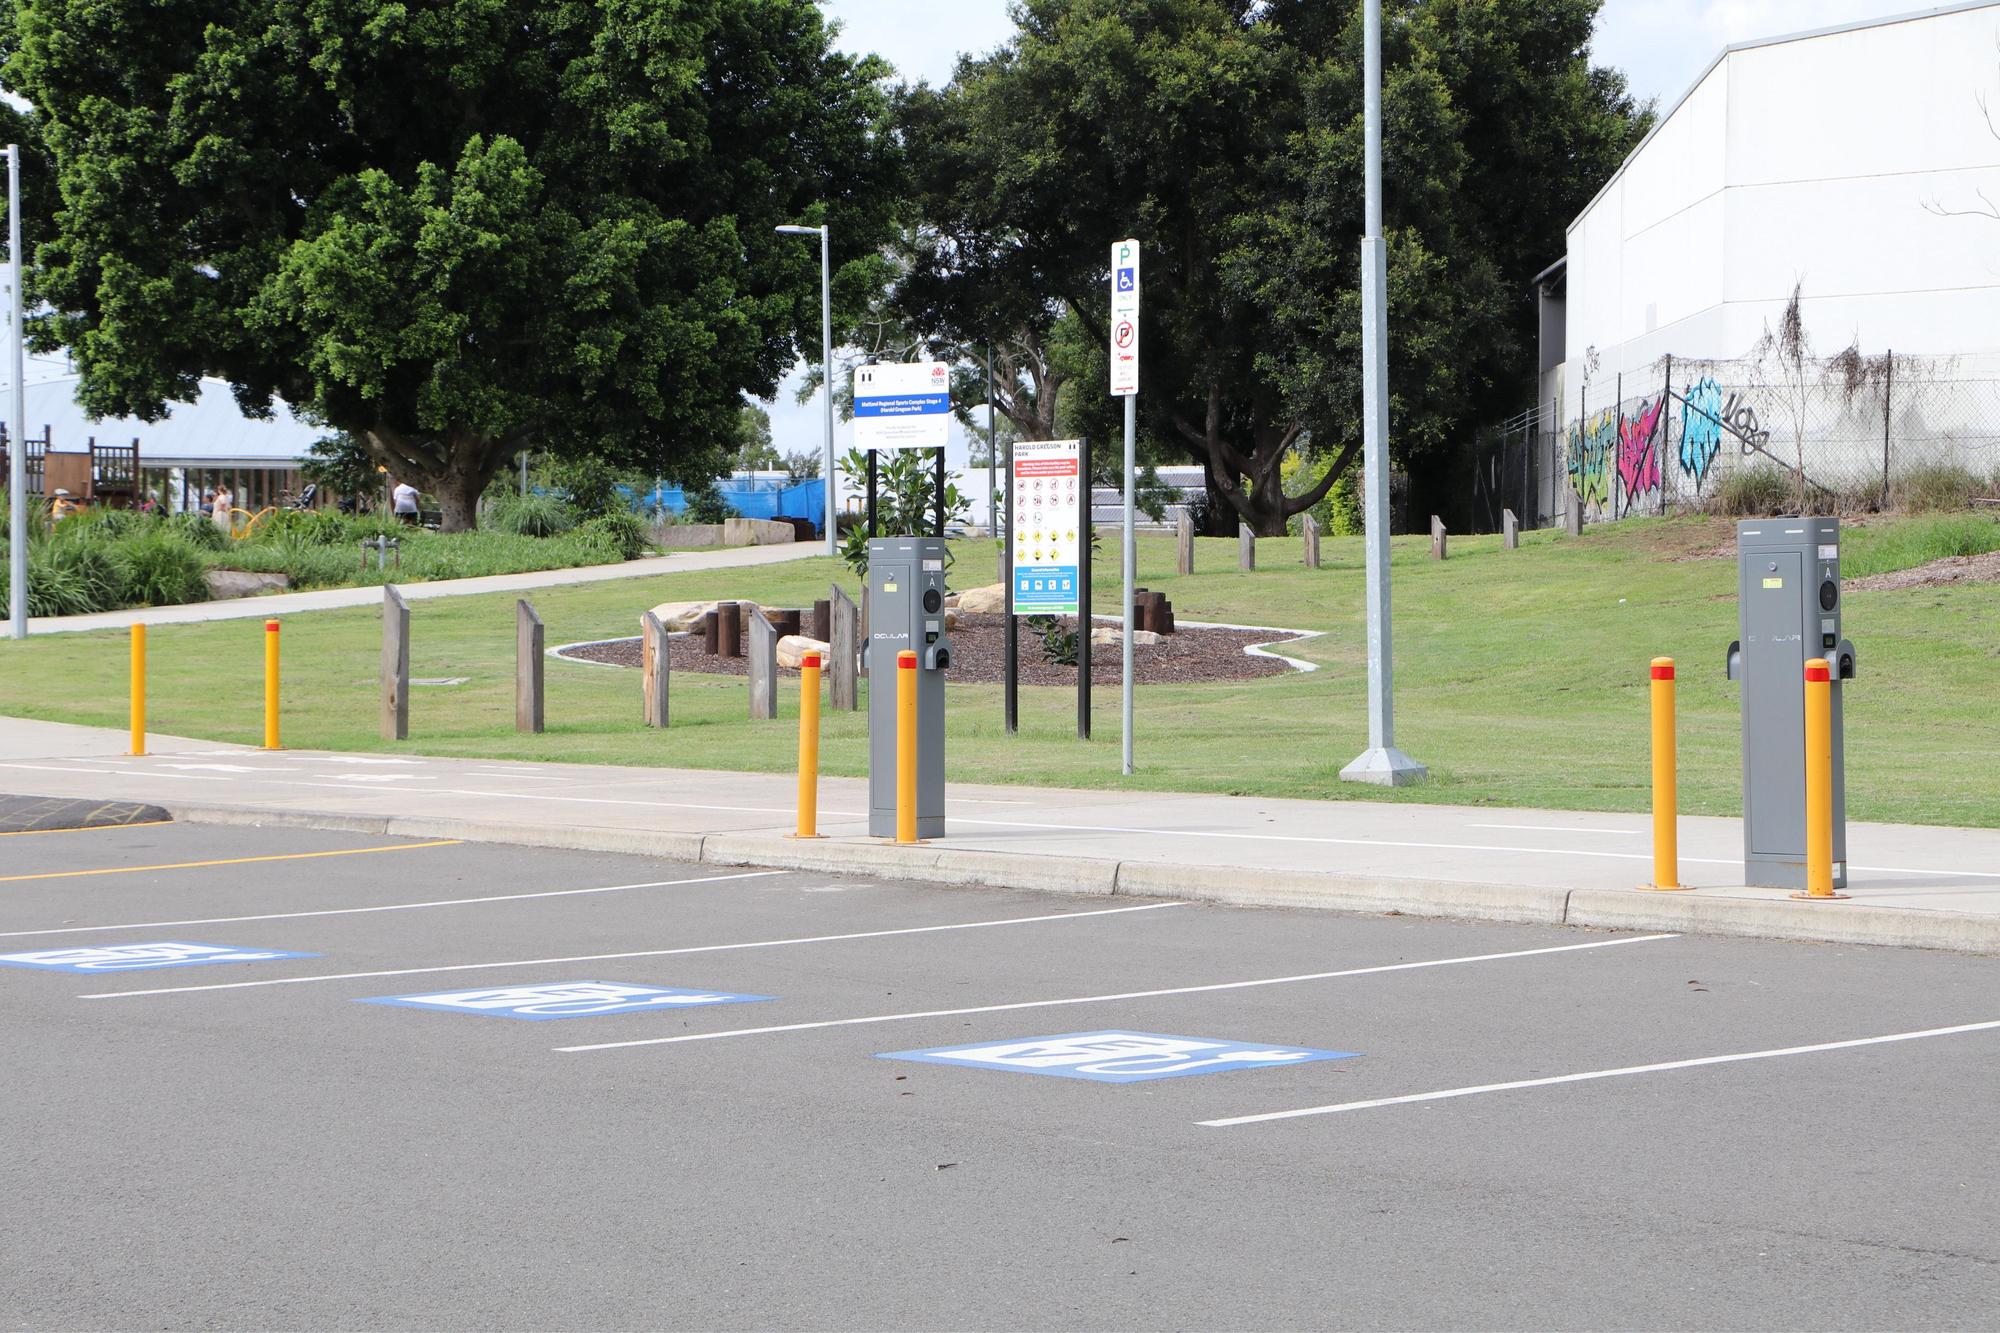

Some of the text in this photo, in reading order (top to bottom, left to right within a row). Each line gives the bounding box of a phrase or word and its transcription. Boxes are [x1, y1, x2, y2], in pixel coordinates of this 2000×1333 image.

[1120, 248, 1131, 265] P
[1120, 328, 1130, 343] P
[1825, 567, 1831, 578] A
[929, 577, 936, 587] A
